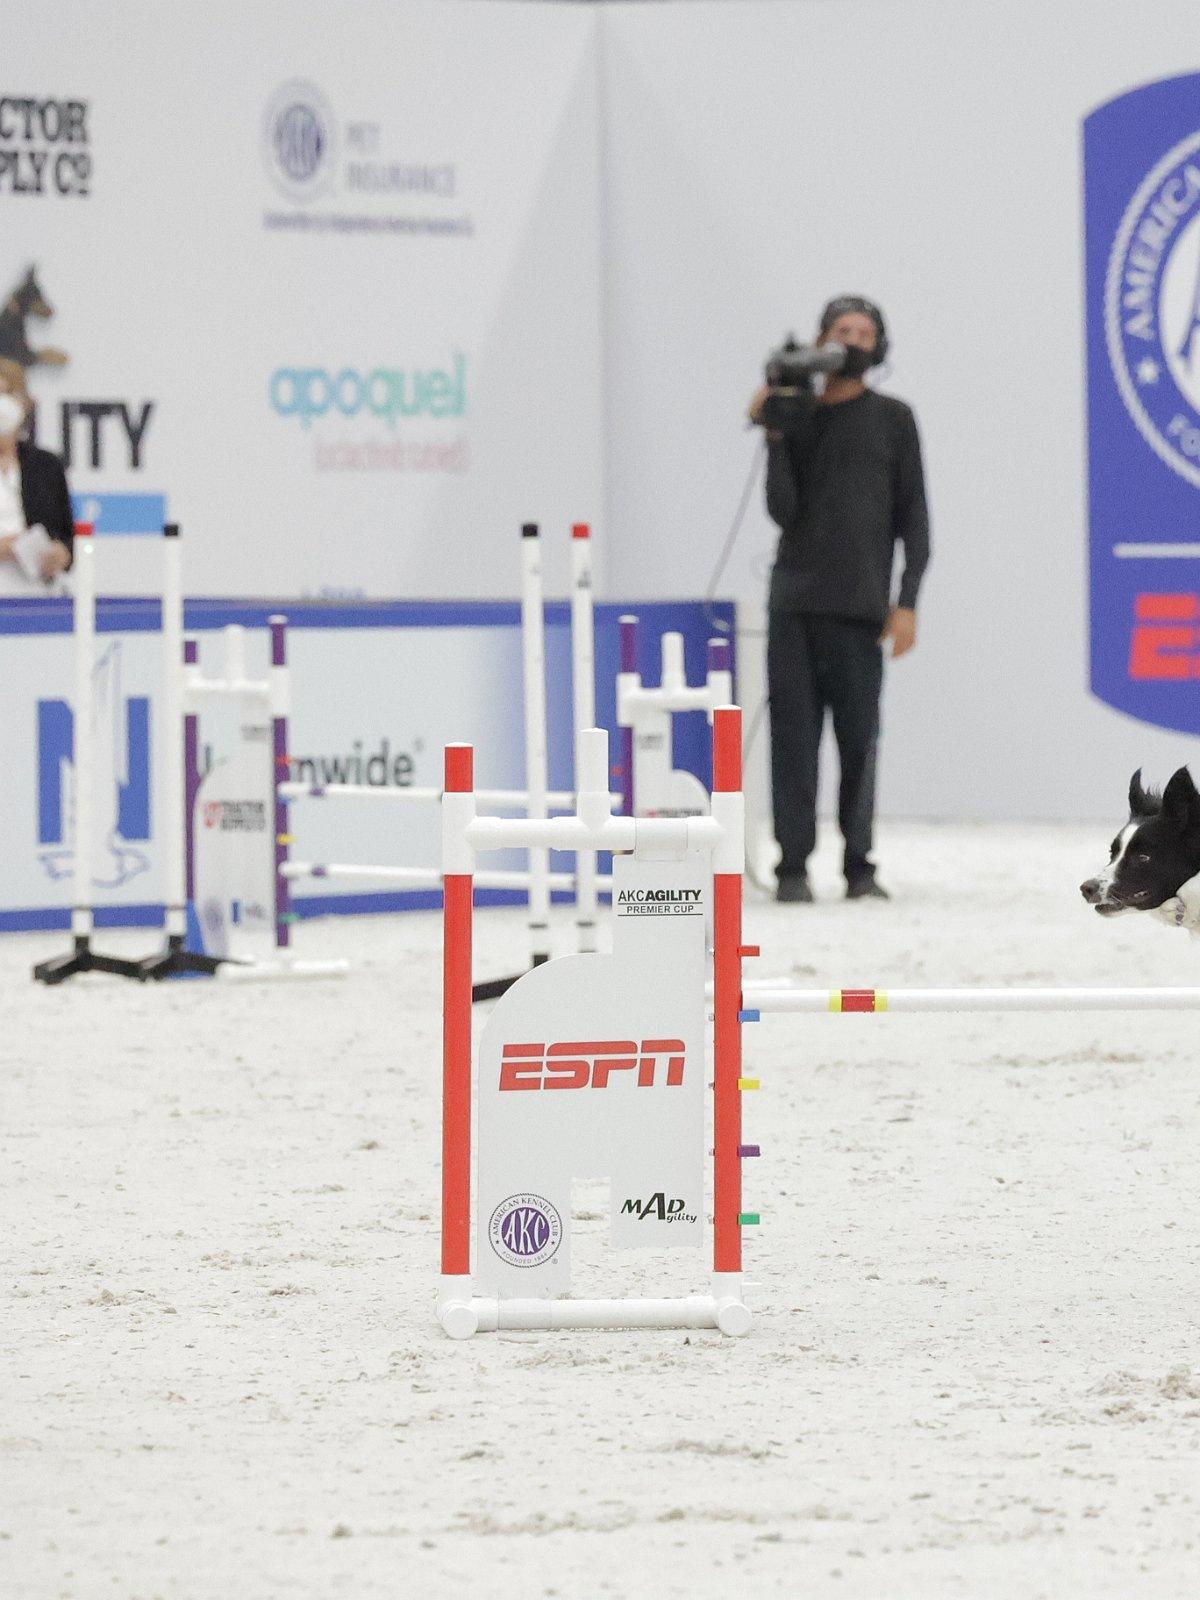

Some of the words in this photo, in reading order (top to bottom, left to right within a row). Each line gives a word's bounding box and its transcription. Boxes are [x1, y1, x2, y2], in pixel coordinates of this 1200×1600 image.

[269, 352, 466, 431] apoquel
[626, 905, 671, 914] PREMIER
[673, 905, 694, 913] CUP
[499, 1039, 686, 1091] ESPN
[492, 1198, 519, 1236] AMERICAN
[522, 1197, 552, 1214] KENNEL
[549, 1214, 559, 1237] CLUB
[503, 1208, 547, 1254] AKC
